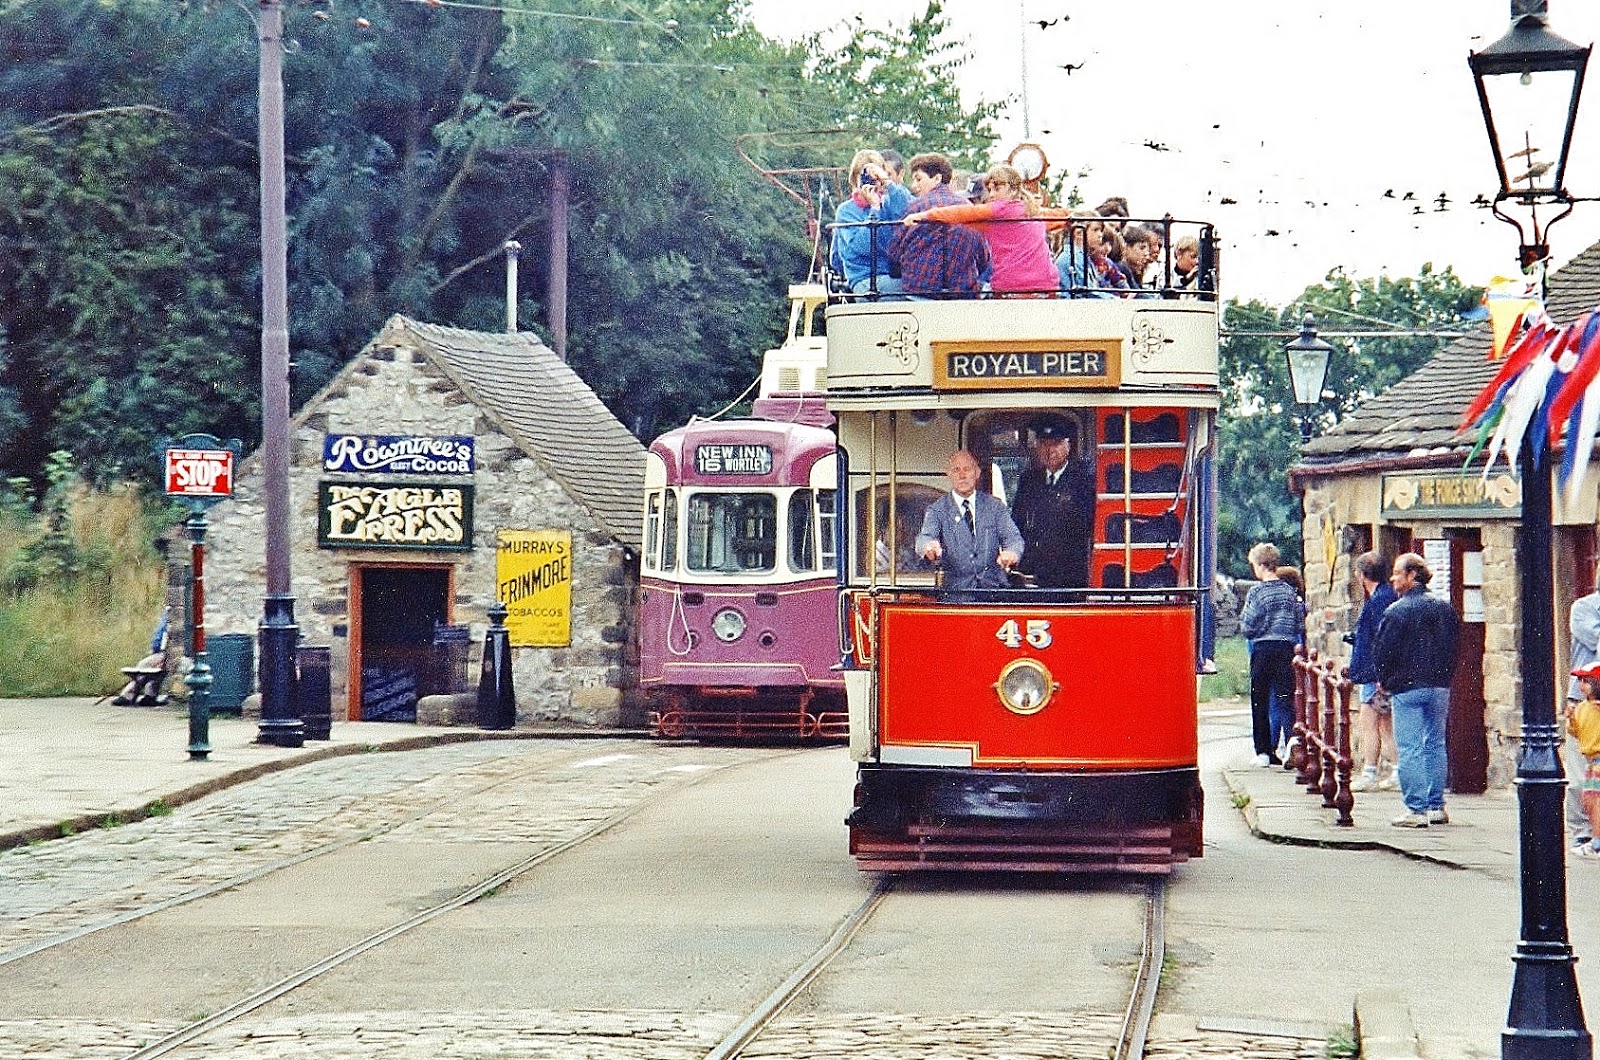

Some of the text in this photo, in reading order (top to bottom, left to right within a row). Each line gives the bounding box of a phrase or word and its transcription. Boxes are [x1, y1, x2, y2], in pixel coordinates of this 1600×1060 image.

[953, 352, 1100, 376] ROYAL PIER
[325, 436, 471, 470] Rowntree's
[698, 445, 767, 459] NEW INN
[176, 460, 223, 486] STOP
[412, 459, 470, 472] Cocoa
[699, 458, 766, 472] 16 WORTLEY
[995, 619, 1053, 649] 45
